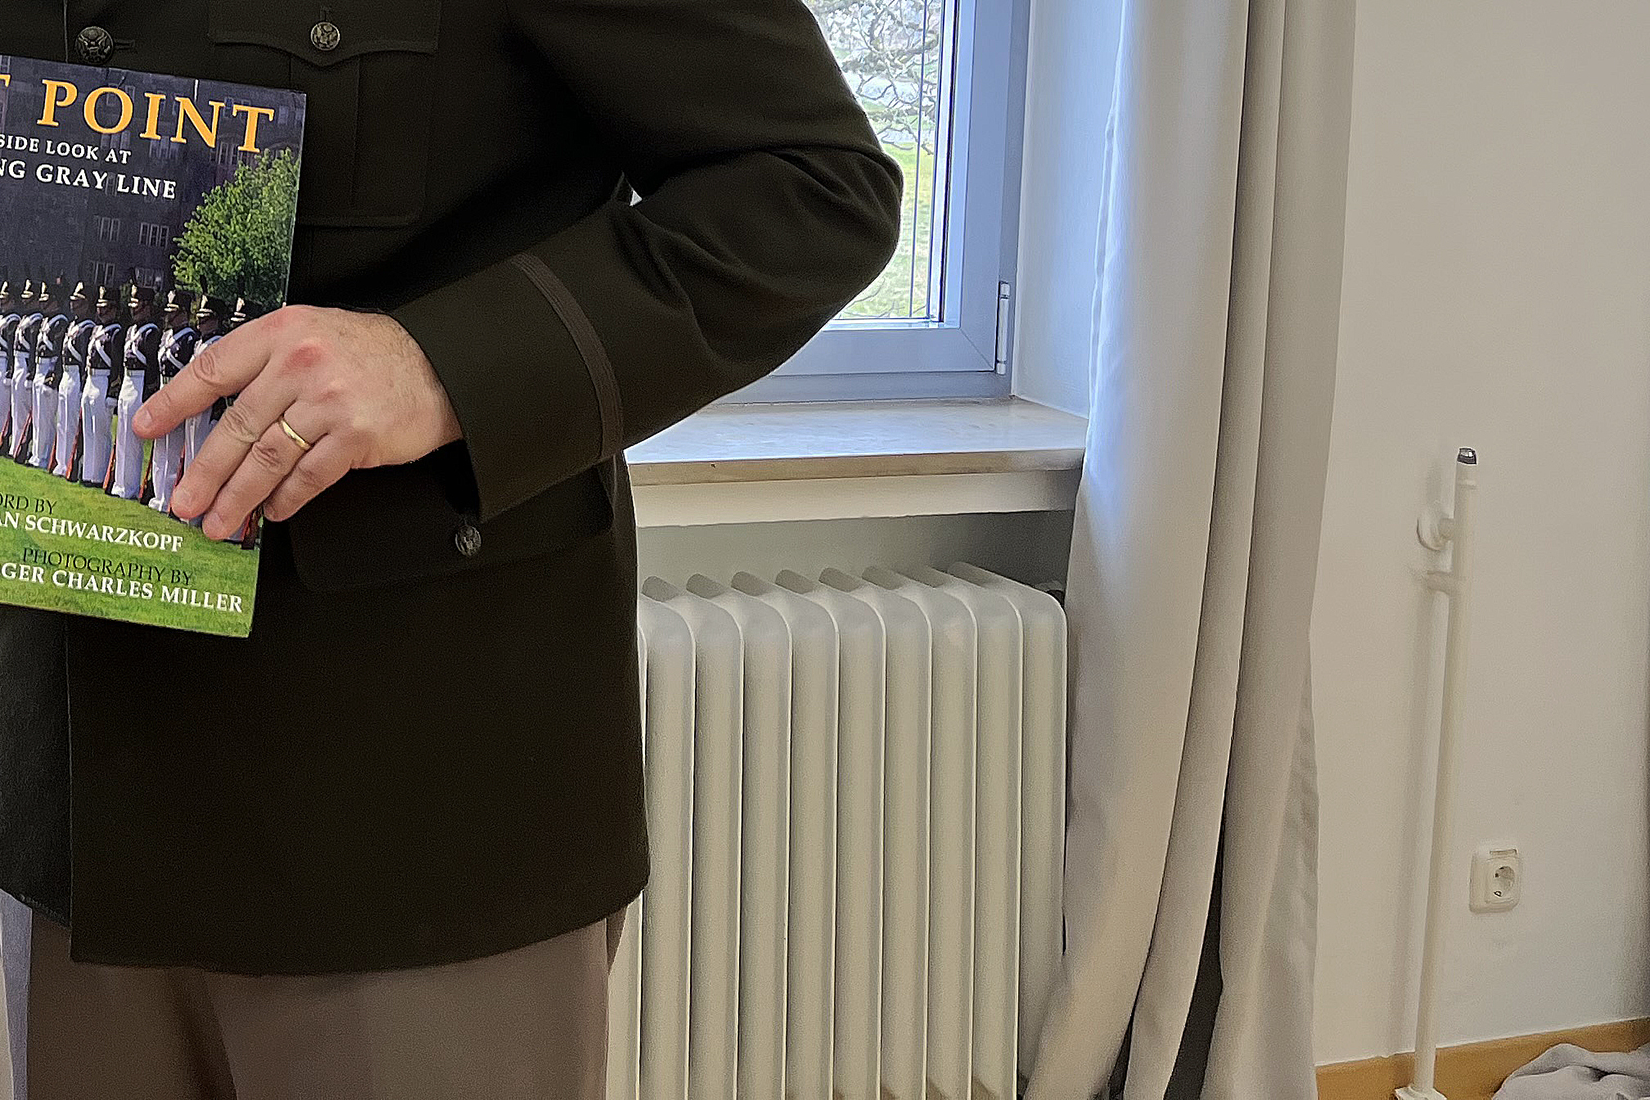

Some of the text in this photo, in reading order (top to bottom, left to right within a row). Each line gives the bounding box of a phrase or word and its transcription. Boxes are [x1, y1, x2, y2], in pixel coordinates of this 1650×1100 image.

[36, 79, 275, 153] POINT
[45, 140, 99, 161] LOOK
[105, 148, 132, 164] AT
[35, 164, 108, 190] GRAY
[117, 174, 177, 199] LINE
[34, 497, 58, 515] BY
[24, 514, 184, 552] SCHWARZKOPF
[22, 547, 195, 586] PHOTOGRAPHY BY
[52, 569, 153, 599] CHARLES
[160, 584, 243, 613] MILLER
